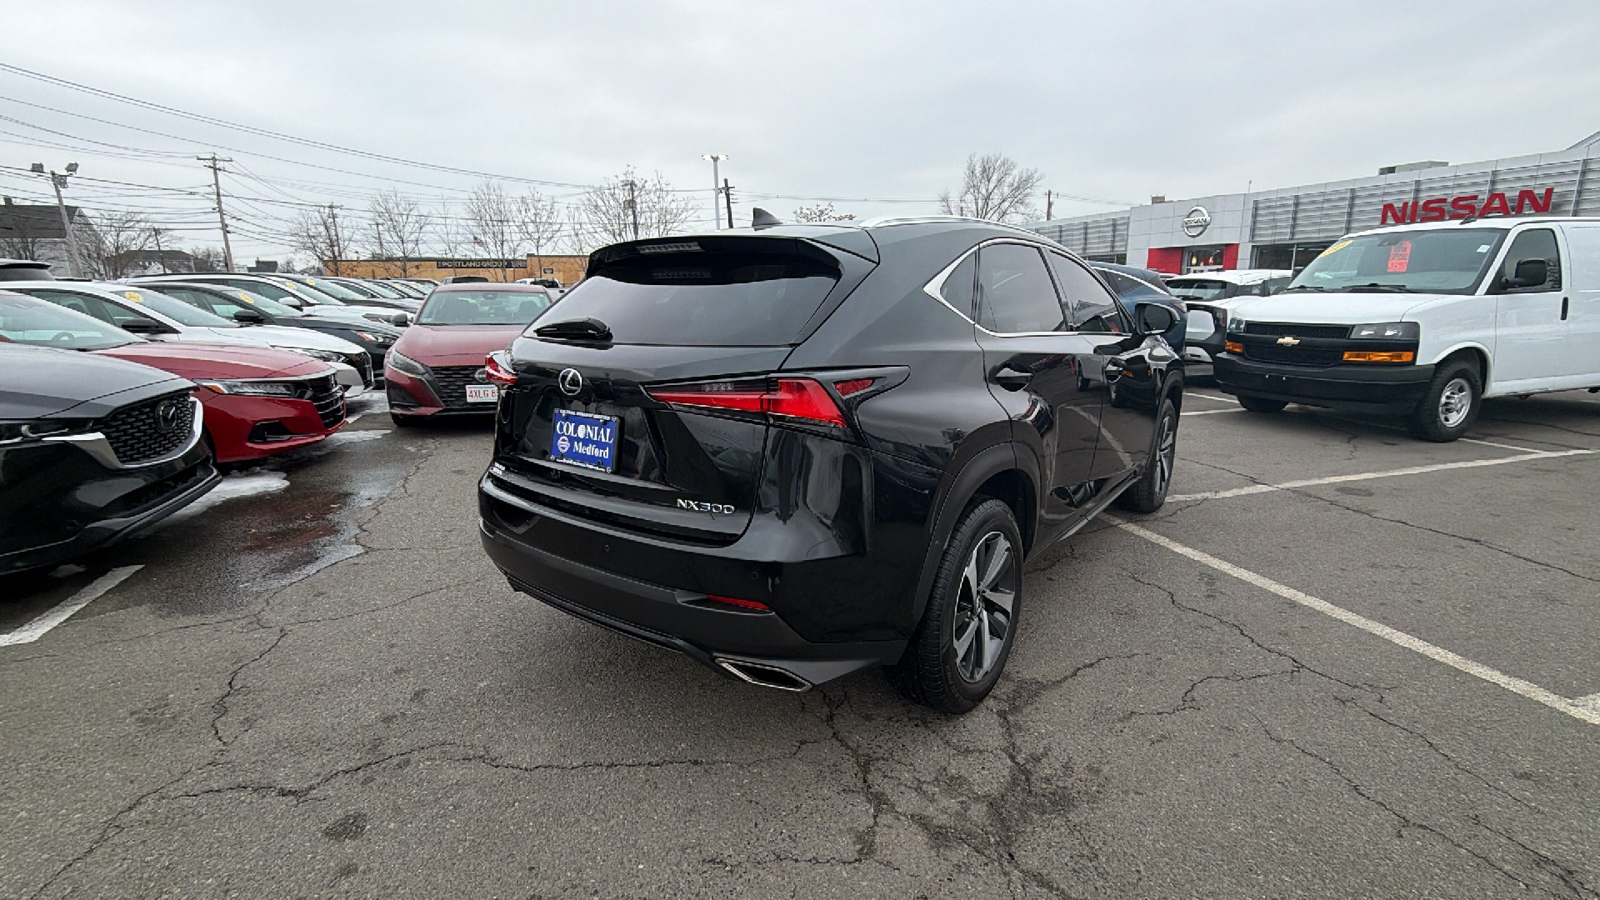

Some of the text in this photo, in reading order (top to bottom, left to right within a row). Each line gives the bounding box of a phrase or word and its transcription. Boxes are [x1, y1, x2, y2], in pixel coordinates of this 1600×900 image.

[1380, 187, 1553, 225] NISSAN
[556, 420, 614, 443] COLONIAL
[573, 440, 609, 459] Medford
[676, 498, 735, 514] NX300
